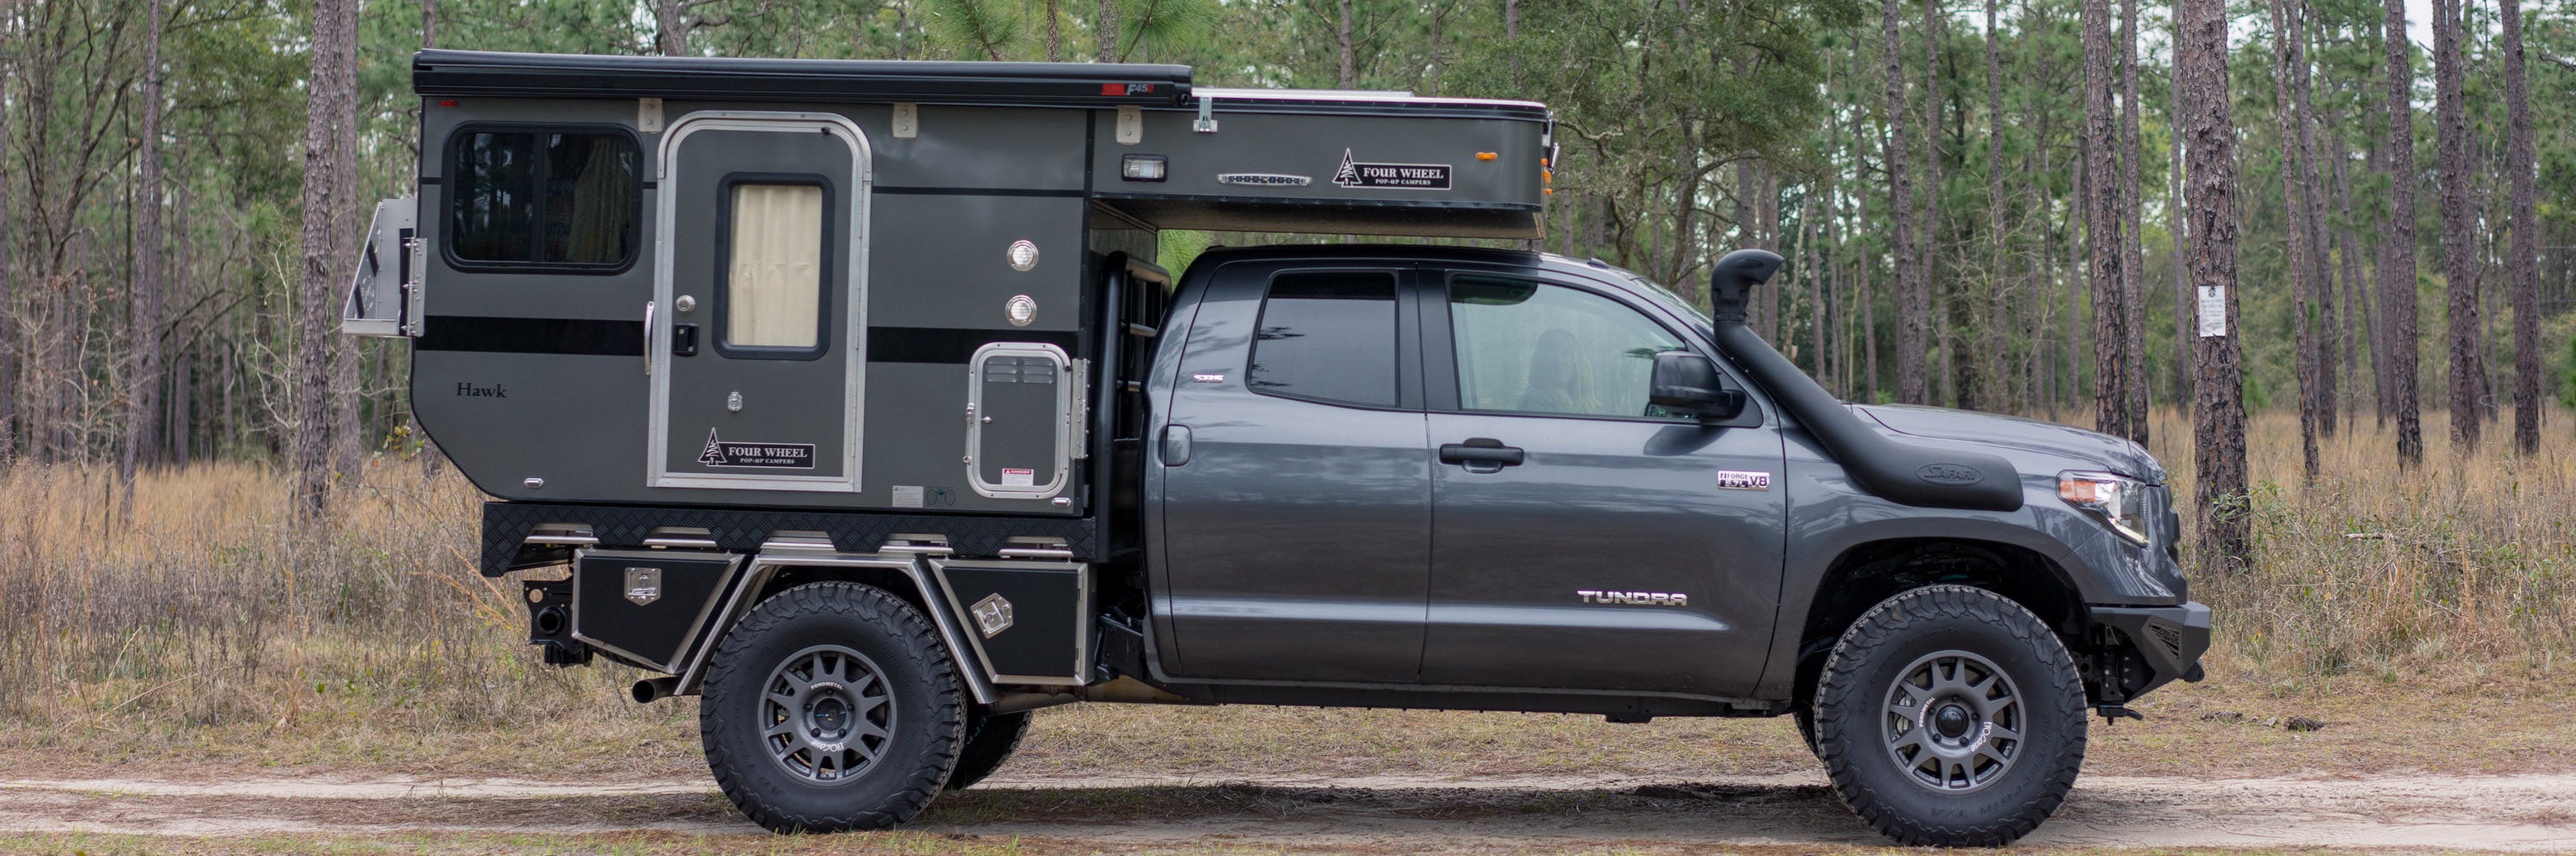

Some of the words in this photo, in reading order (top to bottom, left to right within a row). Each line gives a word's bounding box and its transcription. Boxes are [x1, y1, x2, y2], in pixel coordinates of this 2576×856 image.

[1364, 167, 1397, 178] FOUR
[1400, 168, 1444, 179] WHEEL
[457, 382, 507, 398] Hawk
[728, 446, 762, 457] FOUR
[764, 447, 808, 458] WHEEL
[1750, 476, 1768, 487] V8
[1577, 590, 1687, 606] TUNDRA
